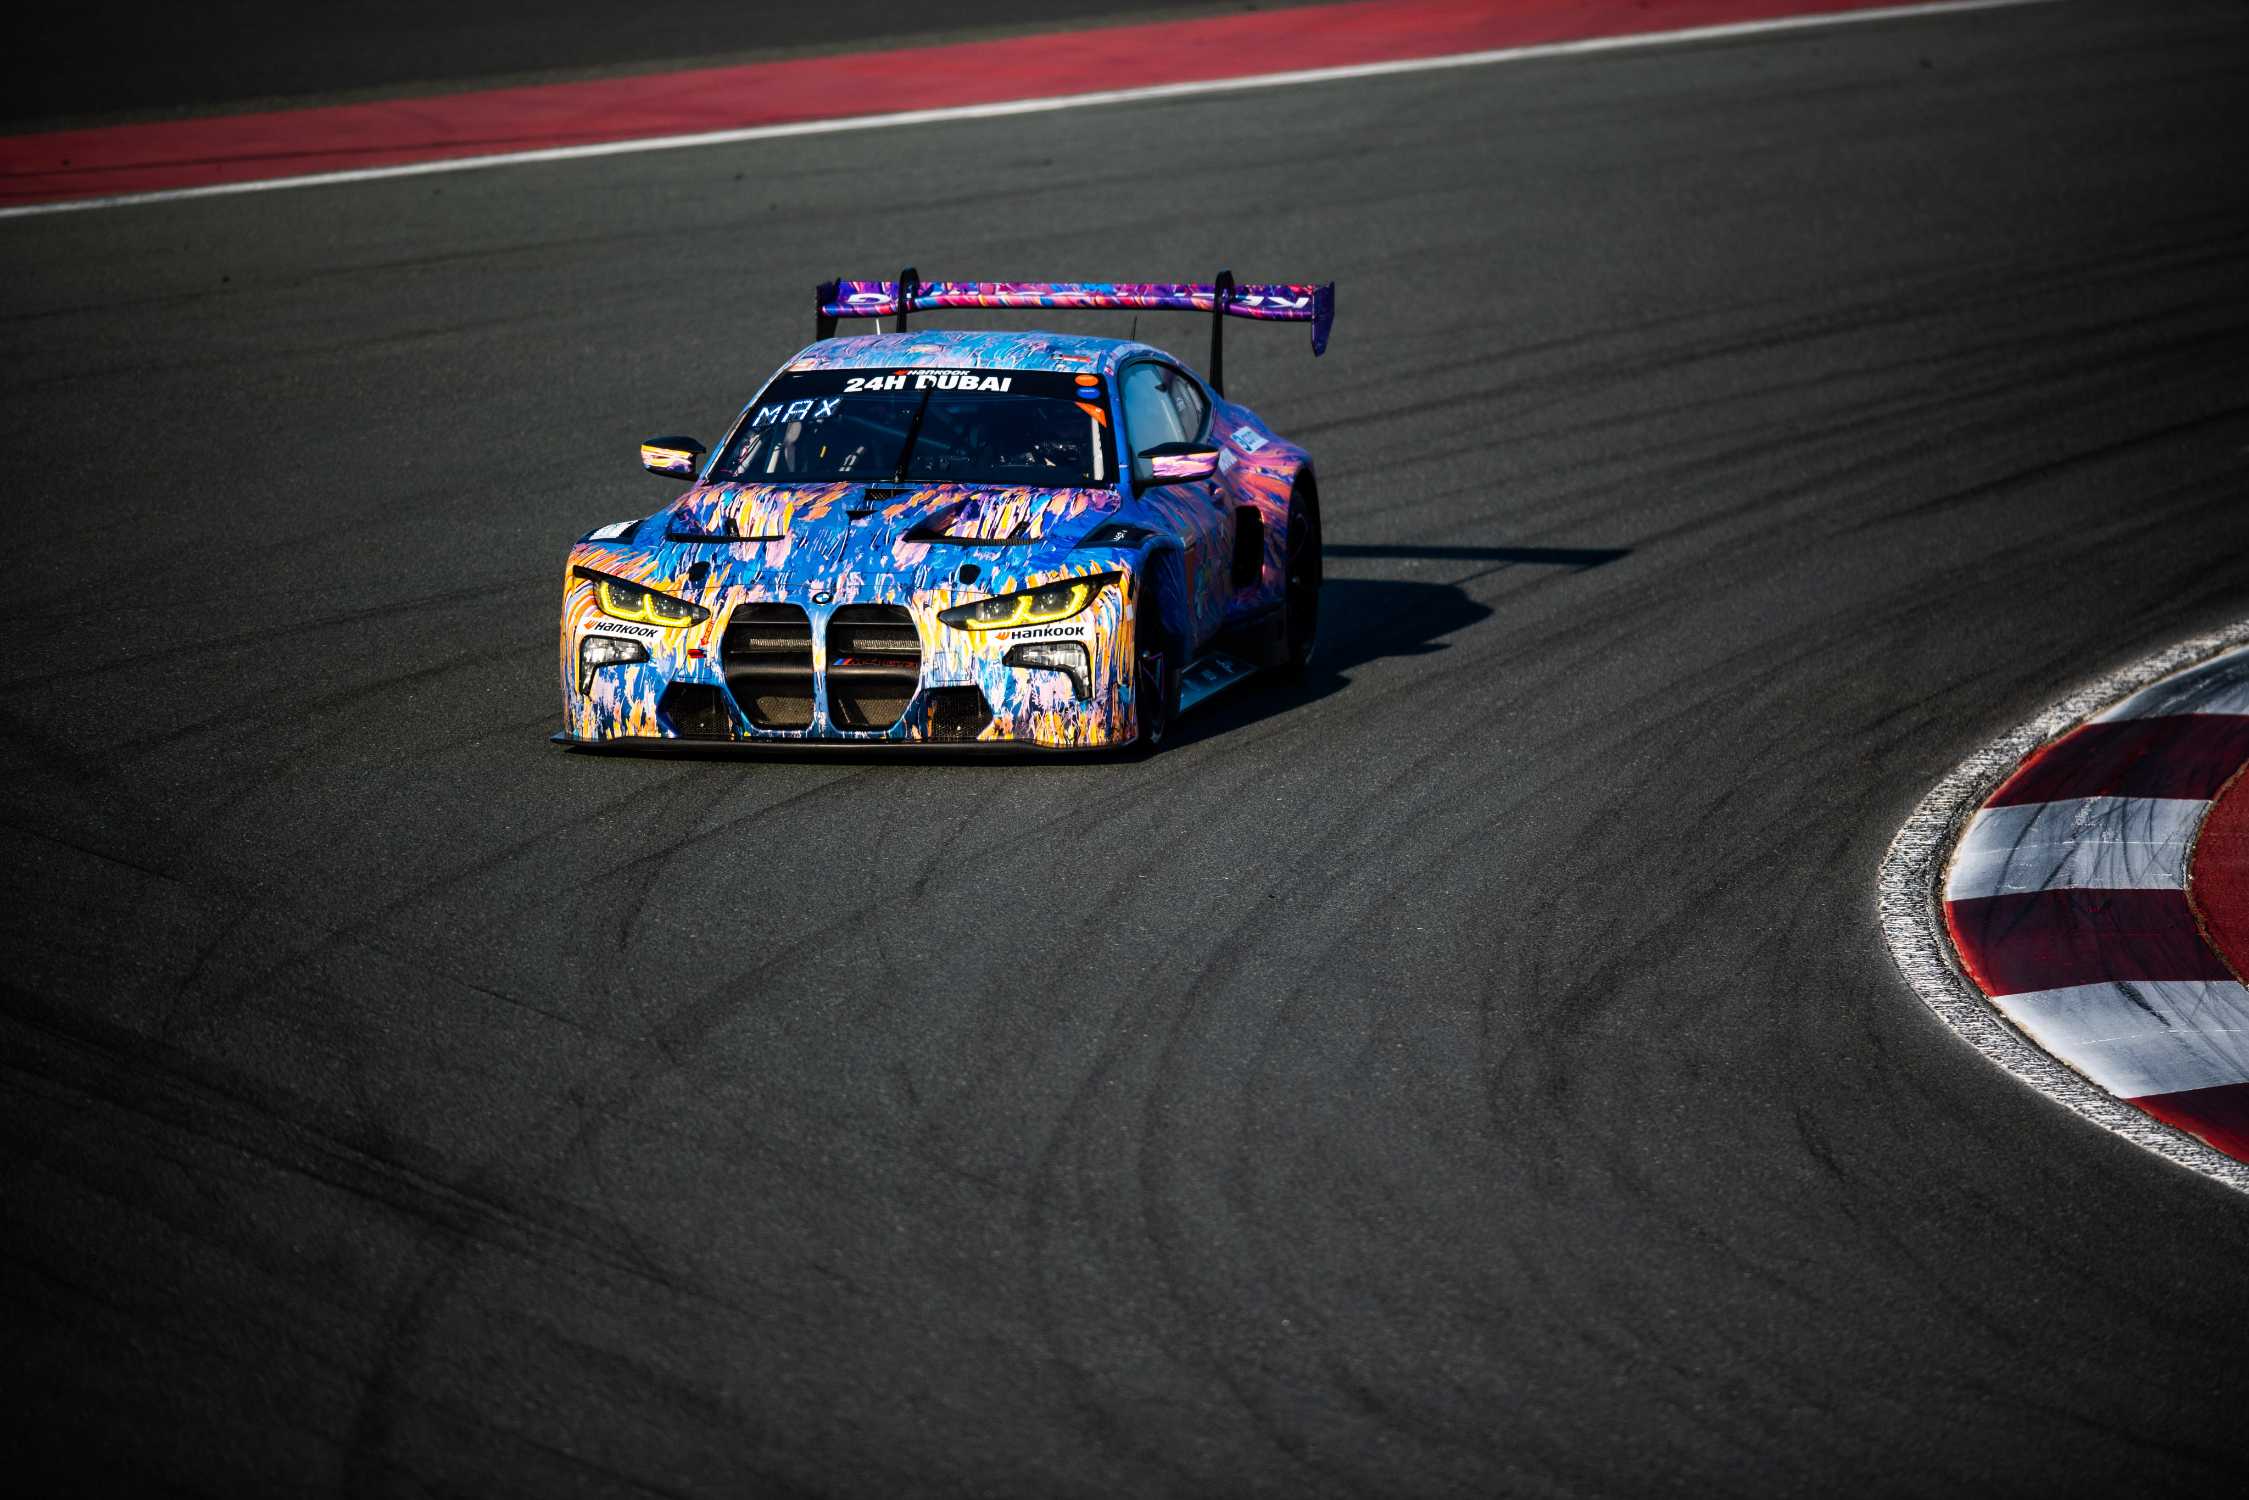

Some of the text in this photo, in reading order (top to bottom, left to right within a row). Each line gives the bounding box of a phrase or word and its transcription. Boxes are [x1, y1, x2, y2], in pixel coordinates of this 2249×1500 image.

[844, 376, 1012, 392] 24H DUBAI
[752, 398, 840, 427] MAX
